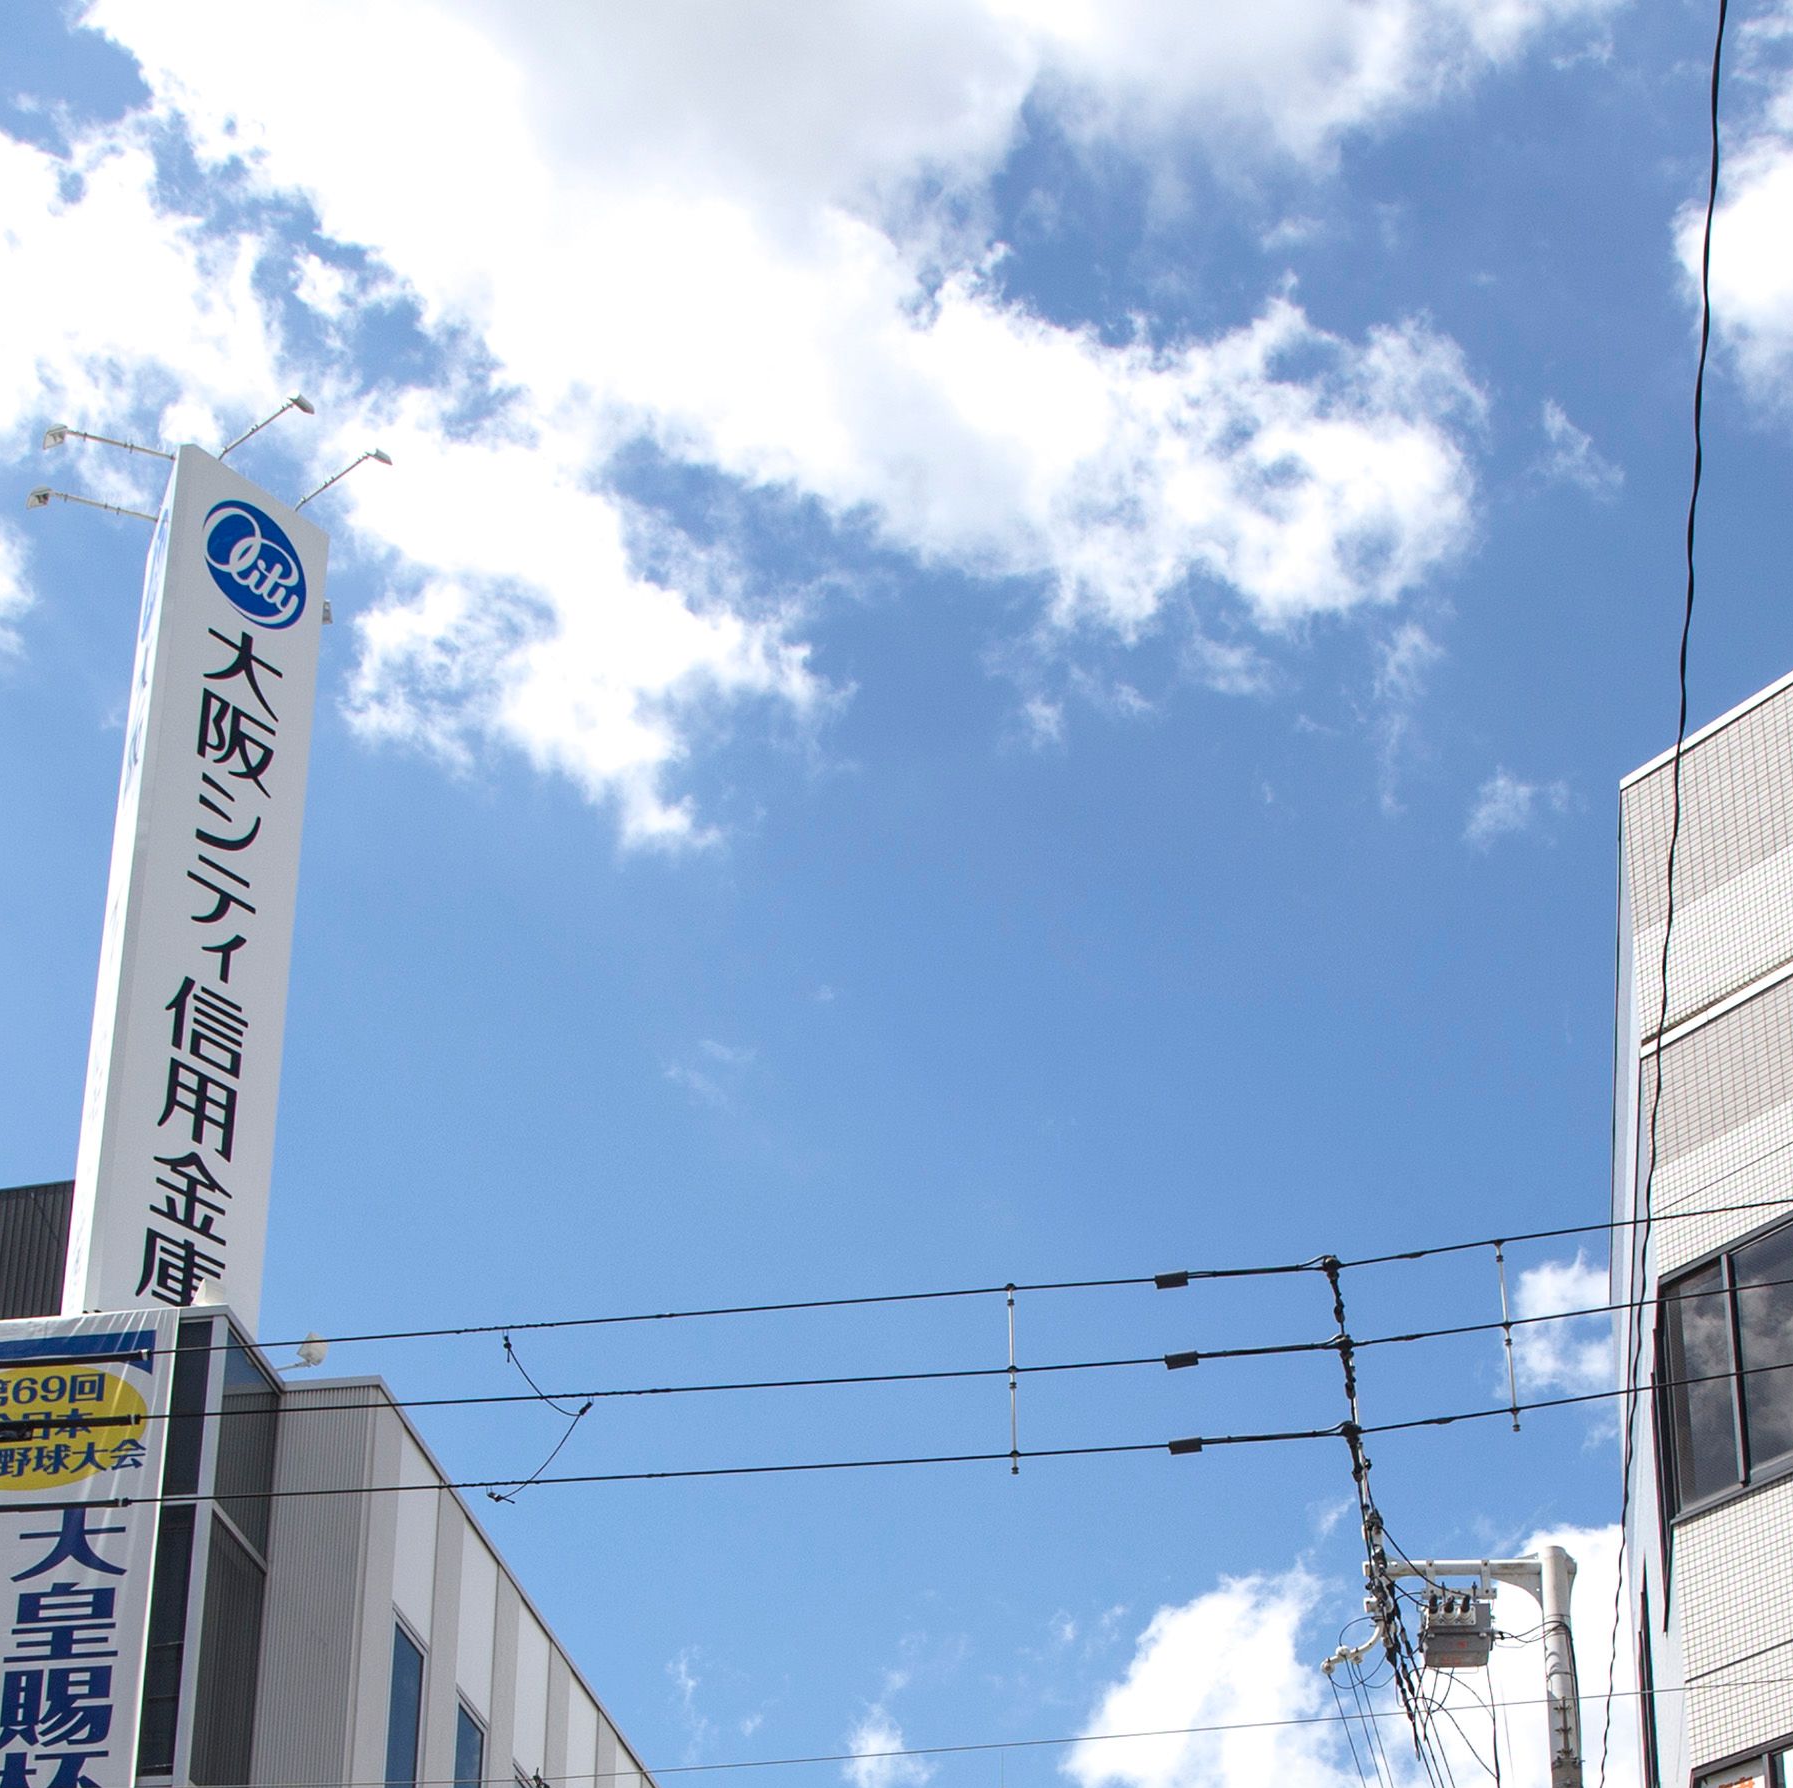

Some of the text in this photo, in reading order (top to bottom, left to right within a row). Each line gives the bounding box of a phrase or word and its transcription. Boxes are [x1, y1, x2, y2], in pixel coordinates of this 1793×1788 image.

[135, 627, 283, 1310] 大阪シティ信用金庫
